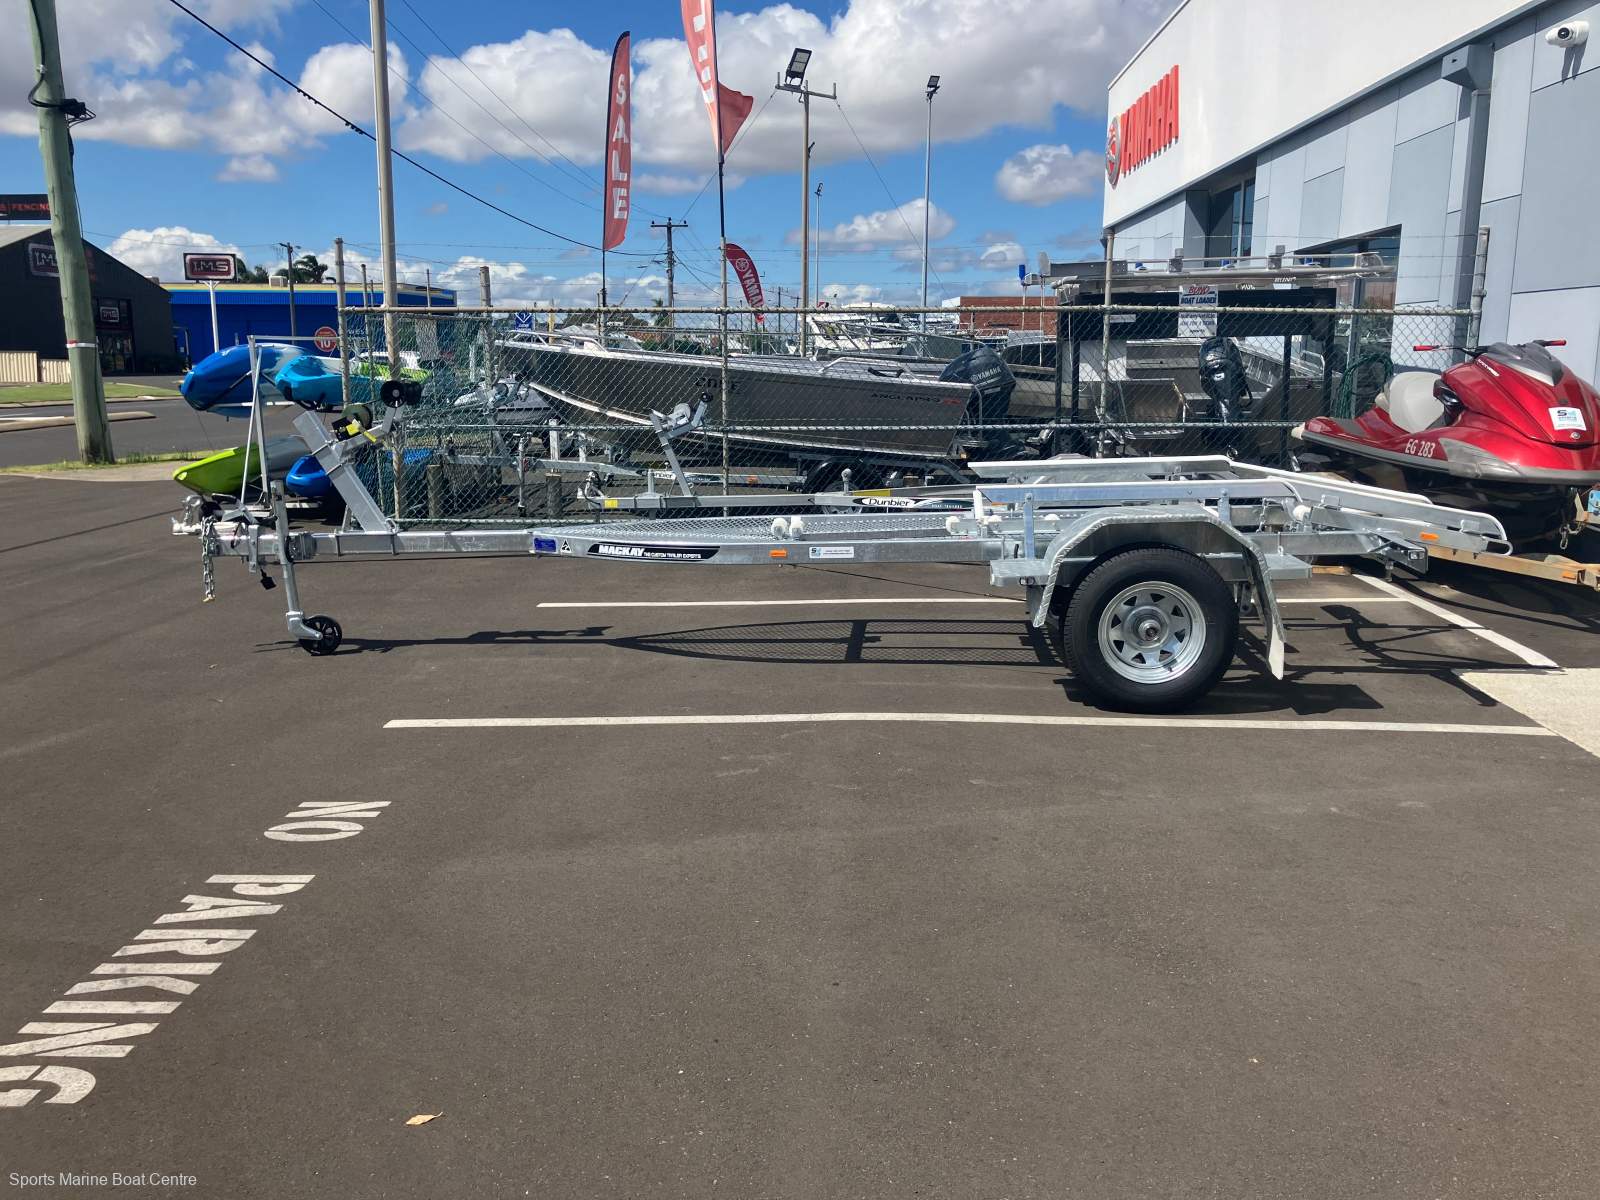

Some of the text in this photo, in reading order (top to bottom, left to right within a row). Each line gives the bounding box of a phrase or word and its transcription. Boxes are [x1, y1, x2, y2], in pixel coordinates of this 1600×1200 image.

[1120, 64, 1179, 175] YAMAHA
[611, 72, 629, 220] SALE
[977, 365, 1002, 380] YAMAHA
[1404, 438, 1436, 458] EG 283
[868, 497, 910, 507] Dunbier
[598, 544, 645, 557] MACKAY
[263, 801, 391, 842] NO
[0, 874, 316, 1107] PARKING
